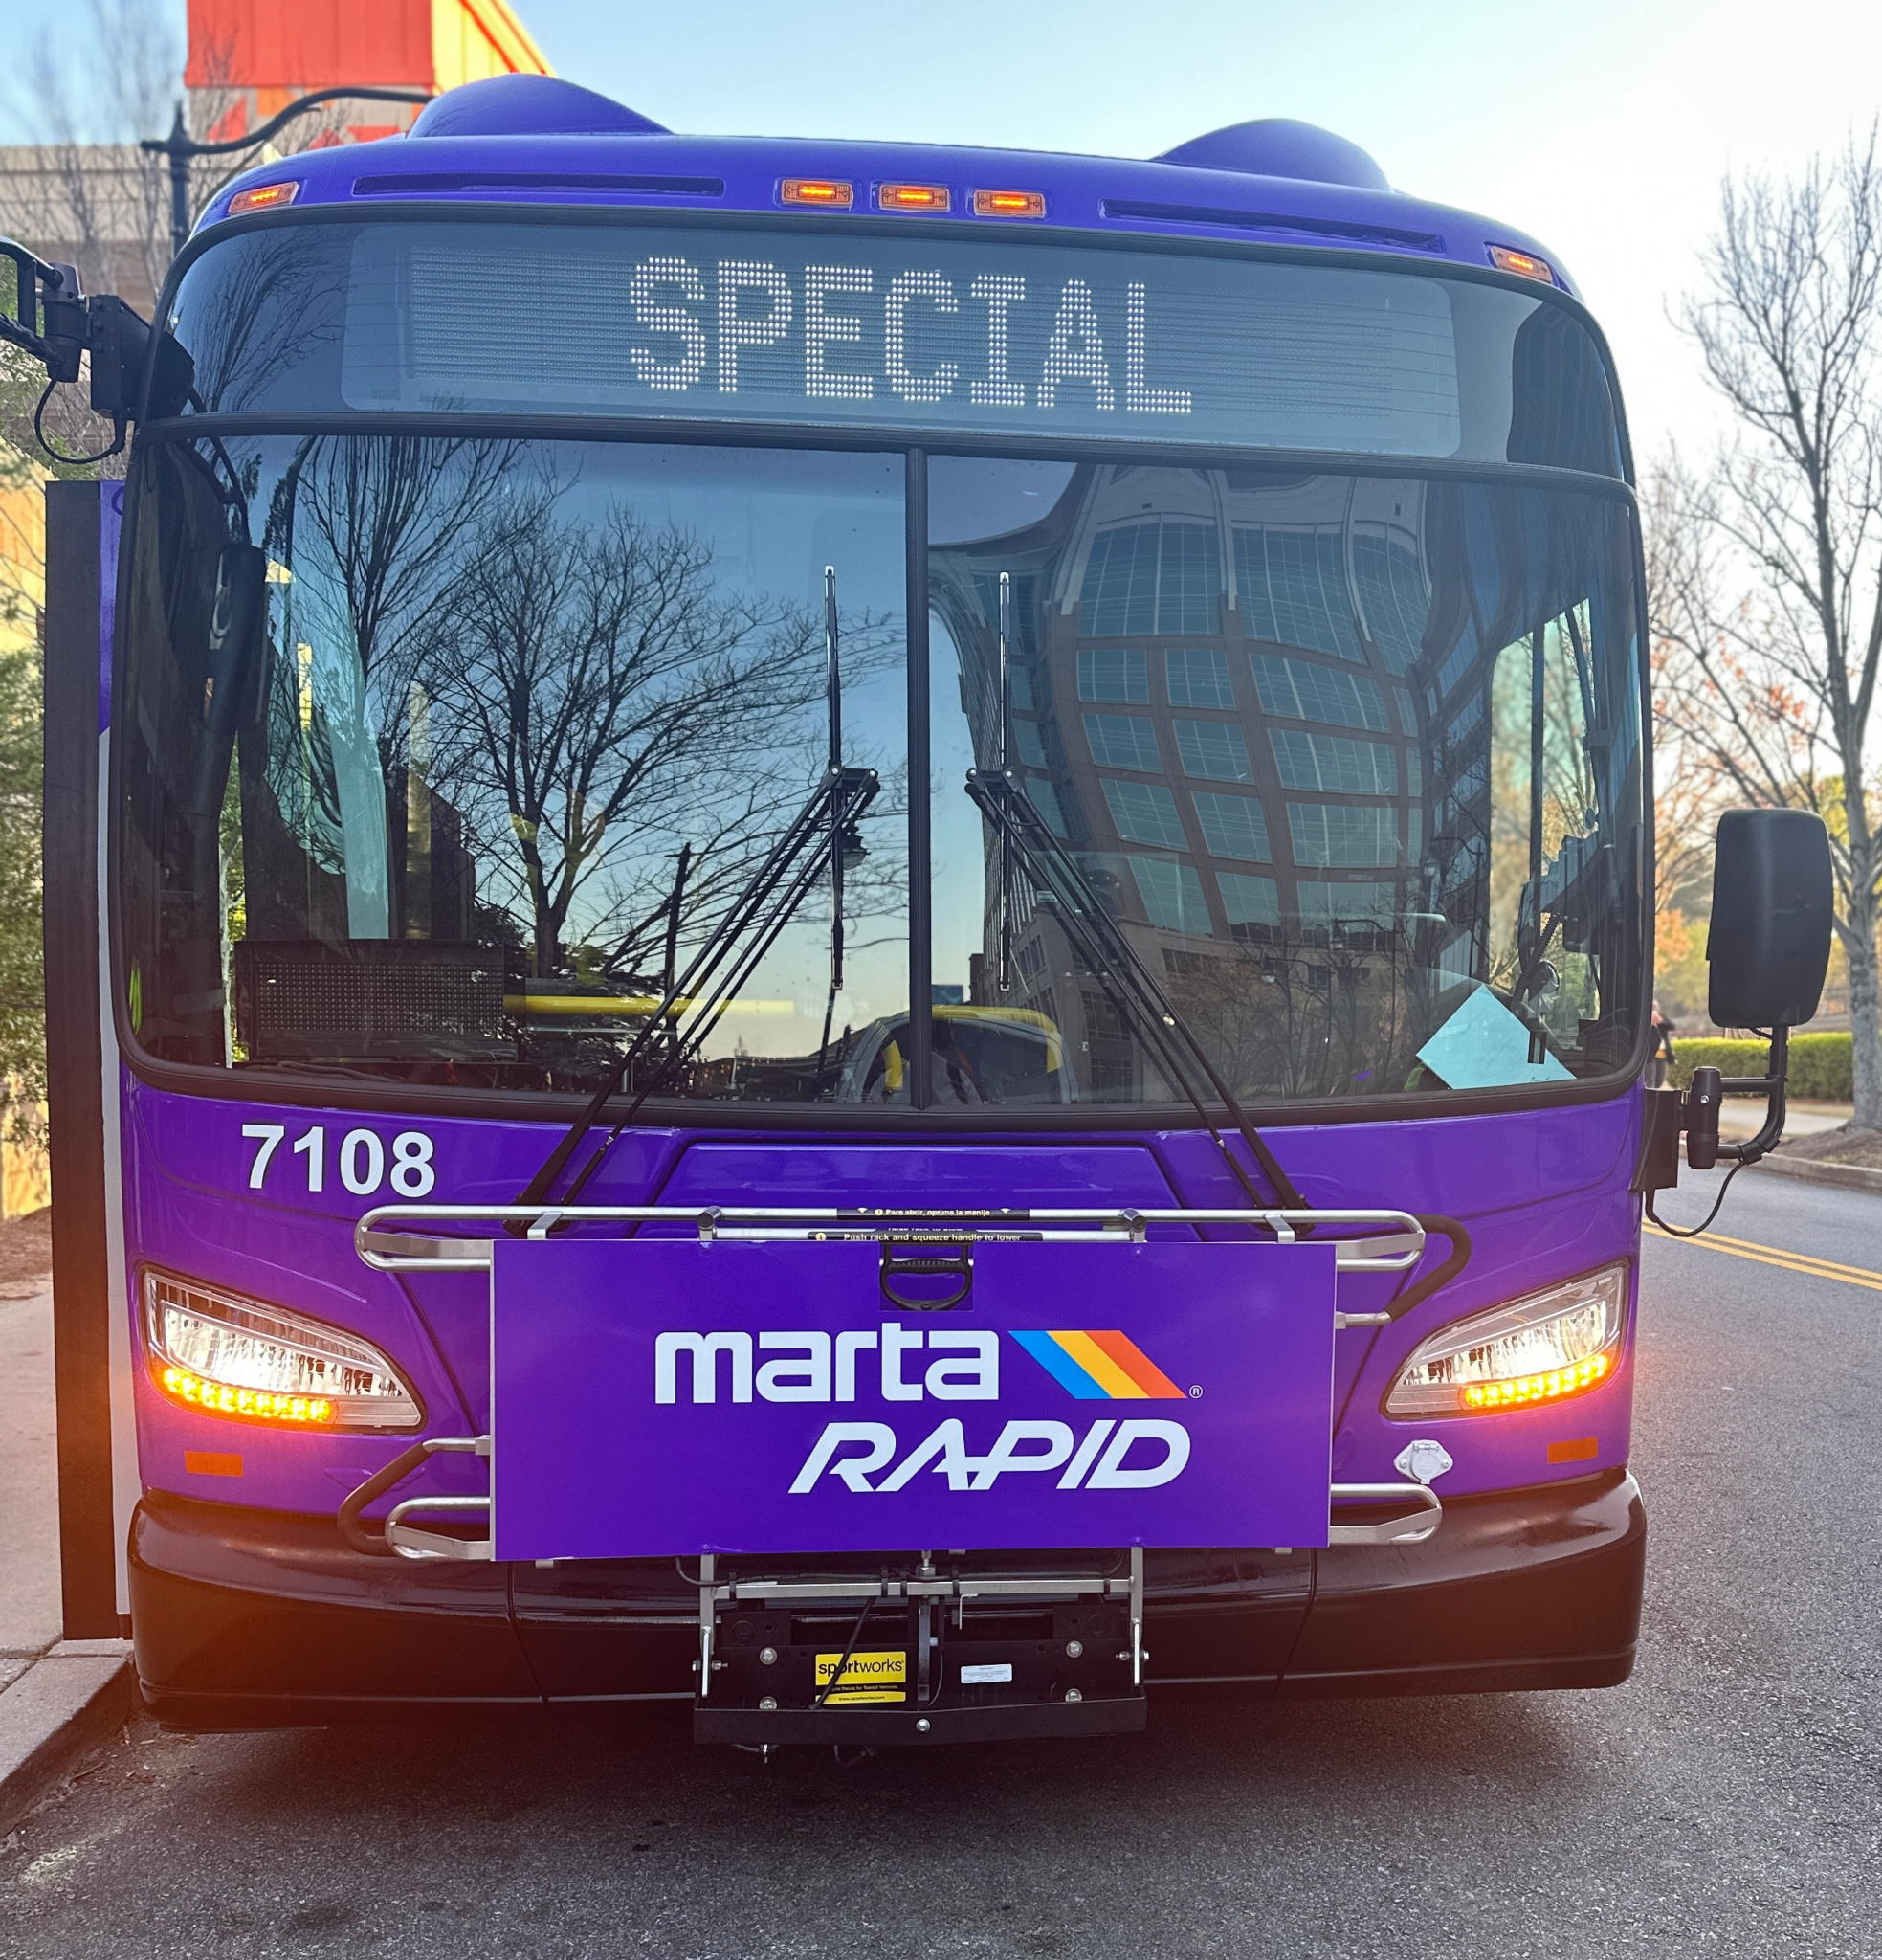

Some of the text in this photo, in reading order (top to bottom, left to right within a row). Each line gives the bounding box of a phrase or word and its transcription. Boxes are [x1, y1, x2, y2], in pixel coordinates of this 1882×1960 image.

[630, 256, 1193, 414] SPECIAL
[241, 1124, 435, 1198] 7108
[912, 1235, 949, 1243] squeeze
[654, 1322, 1000, 1404] marta
[787, 1418, 1191, 1494] RAPID
